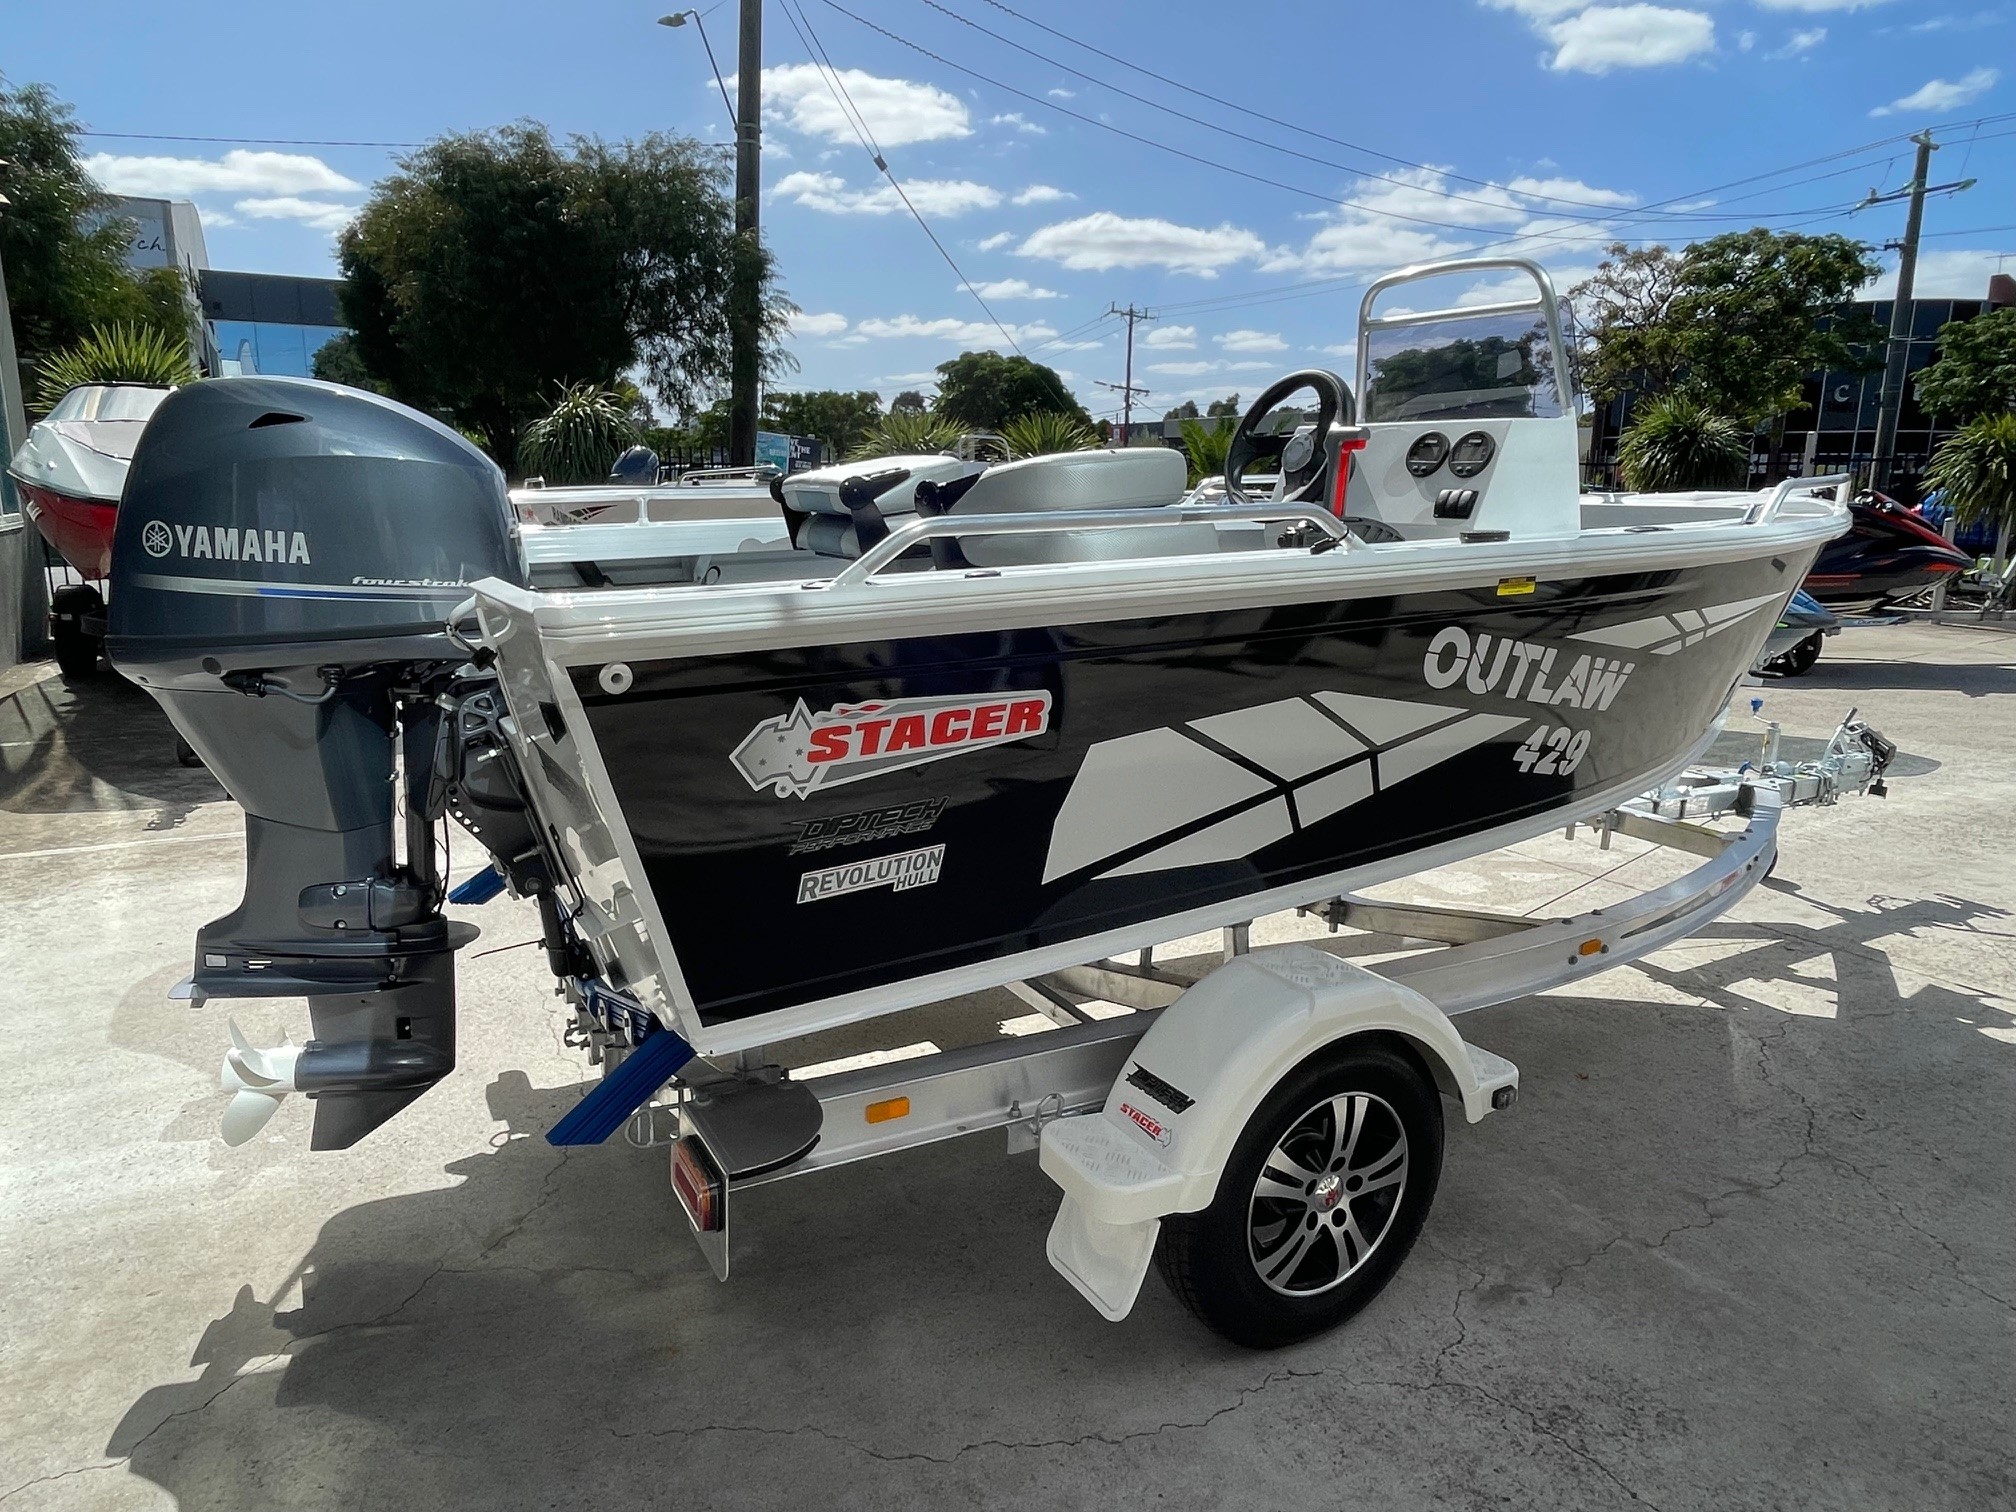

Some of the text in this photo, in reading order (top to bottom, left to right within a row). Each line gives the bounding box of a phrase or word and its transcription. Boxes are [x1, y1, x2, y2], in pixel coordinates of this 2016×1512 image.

[131, 236, 166, 252] ch.
[789, 451, 801, 459] NT
[790, 438, 800, 446] VE
[797, 445, 811, 455] THE
[174, 523, 311, 565] YAMAHA
[352, 576, 467, 588] fourstrok
[1423, 626, 1636, 711] OUTLAW
[806, 699, 1046, 764] STACER
[1512, 724, 1592, 777] 429
[786, 796, 950, 843] DIPTECH
[800, 849, 943, 900] REVOLUTION
[895, 866, 938, 889] HULL
[1120, 1103, 1162, 1137] STACER
